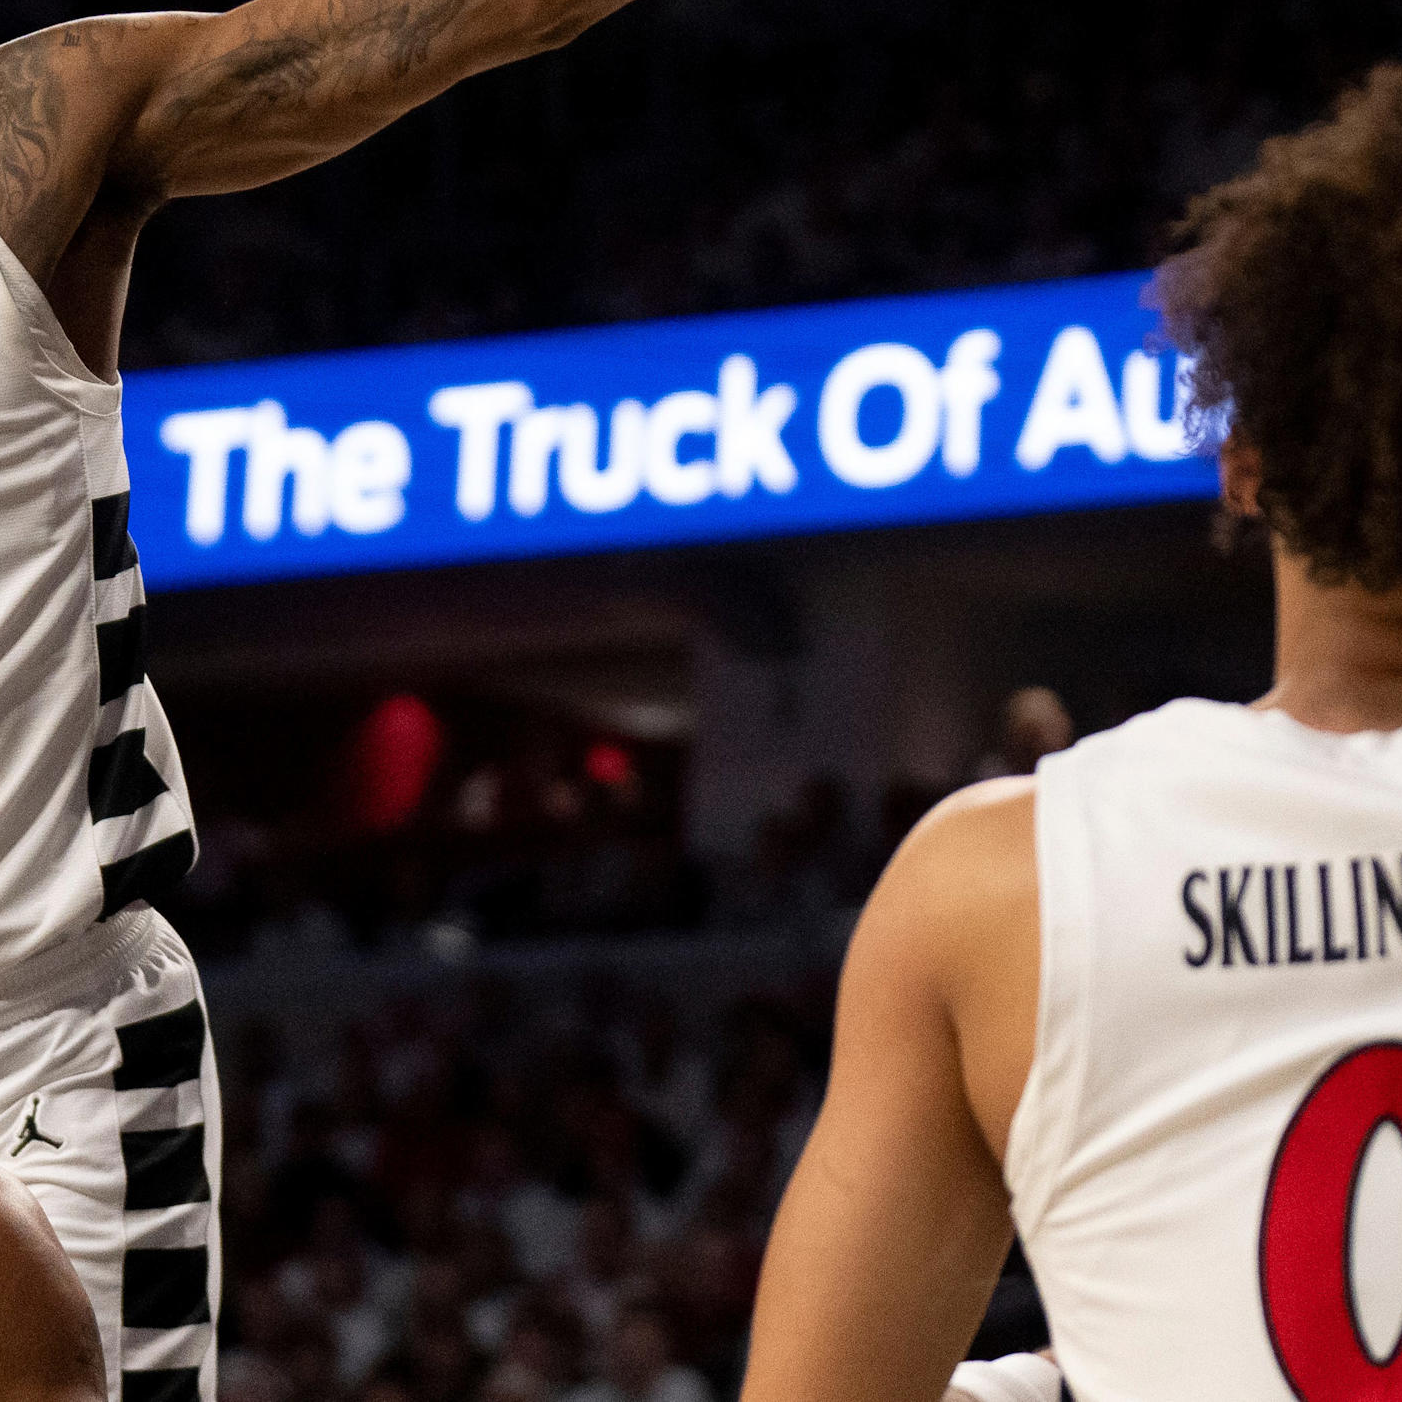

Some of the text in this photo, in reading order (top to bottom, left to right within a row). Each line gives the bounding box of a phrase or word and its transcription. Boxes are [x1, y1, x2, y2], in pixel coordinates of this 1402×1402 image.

[161, 398, 409, 544] The
[430, 350, 797, 523] Truck
[816, 326, 1001, 491] Of
